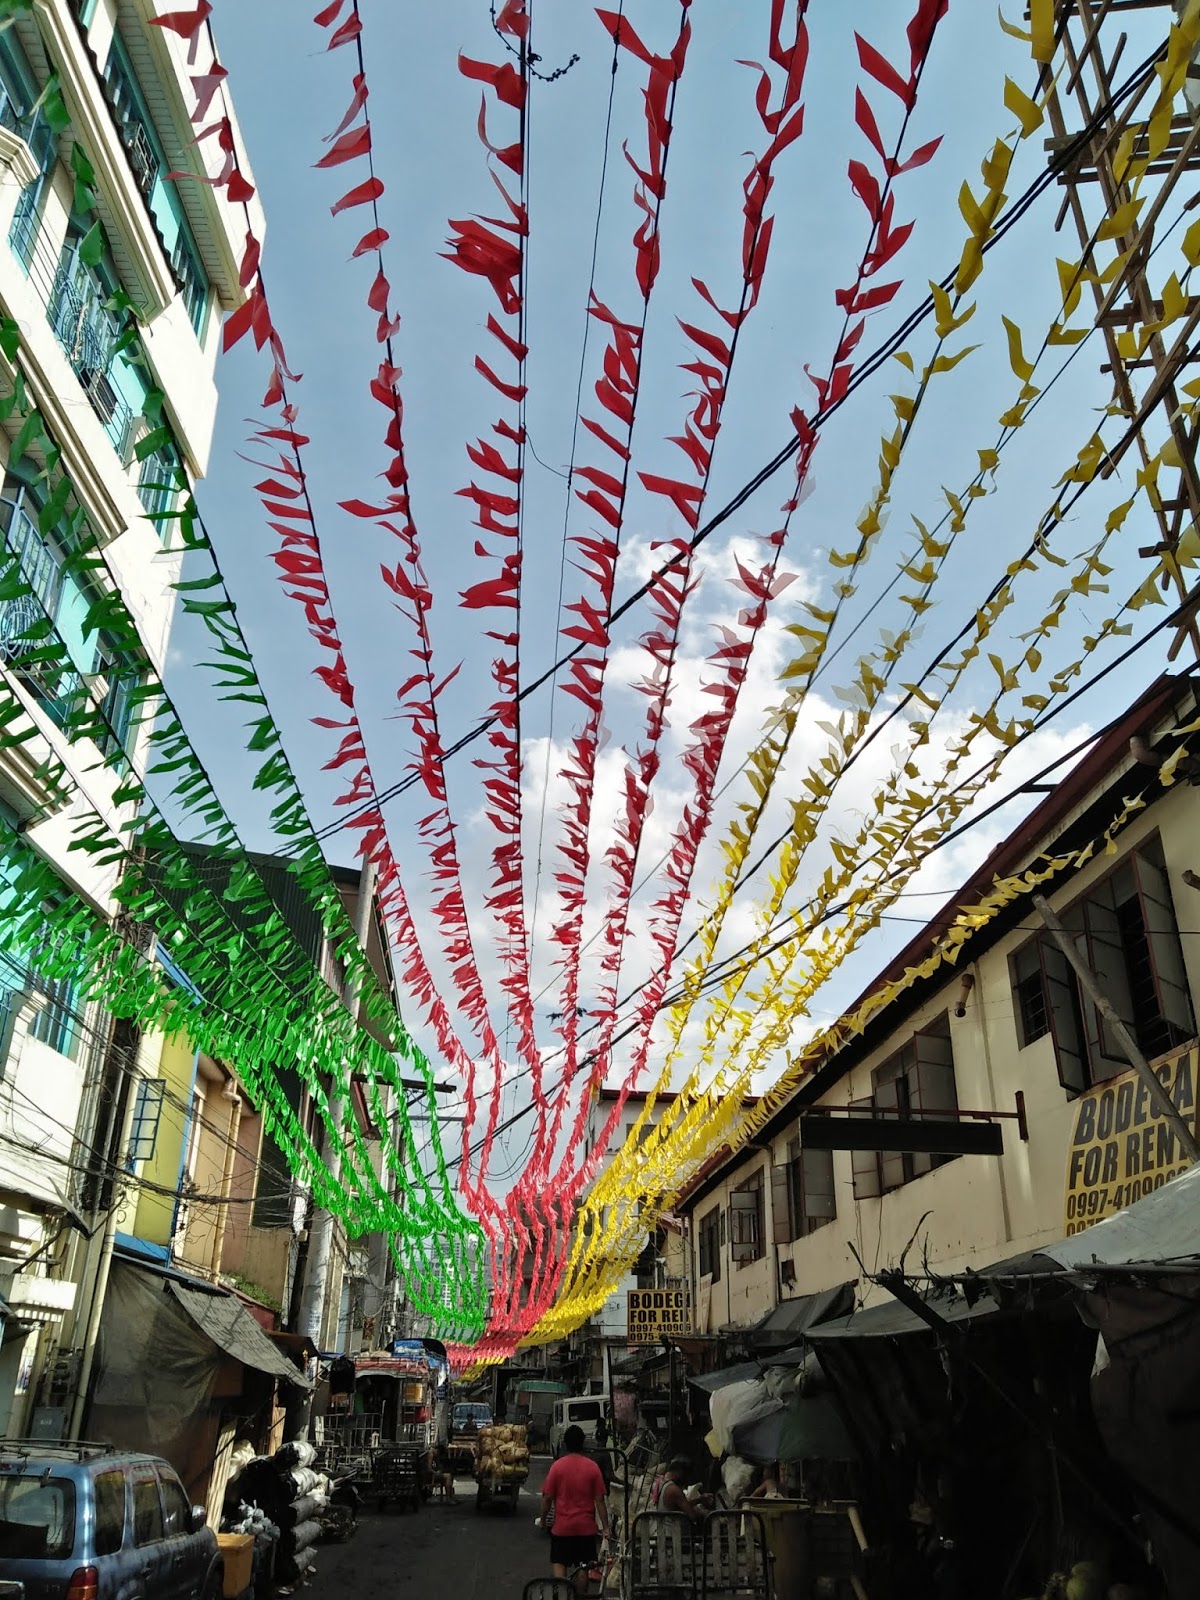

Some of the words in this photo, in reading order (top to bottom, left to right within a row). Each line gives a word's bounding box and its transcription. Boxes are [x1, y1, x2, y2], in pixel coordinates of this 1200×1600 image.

[1073, 1052, 1194, 1146] BODEGA
[1069, 1141, 1118, 1190] FOR
[630, 1310, 657, 1323] FOR
